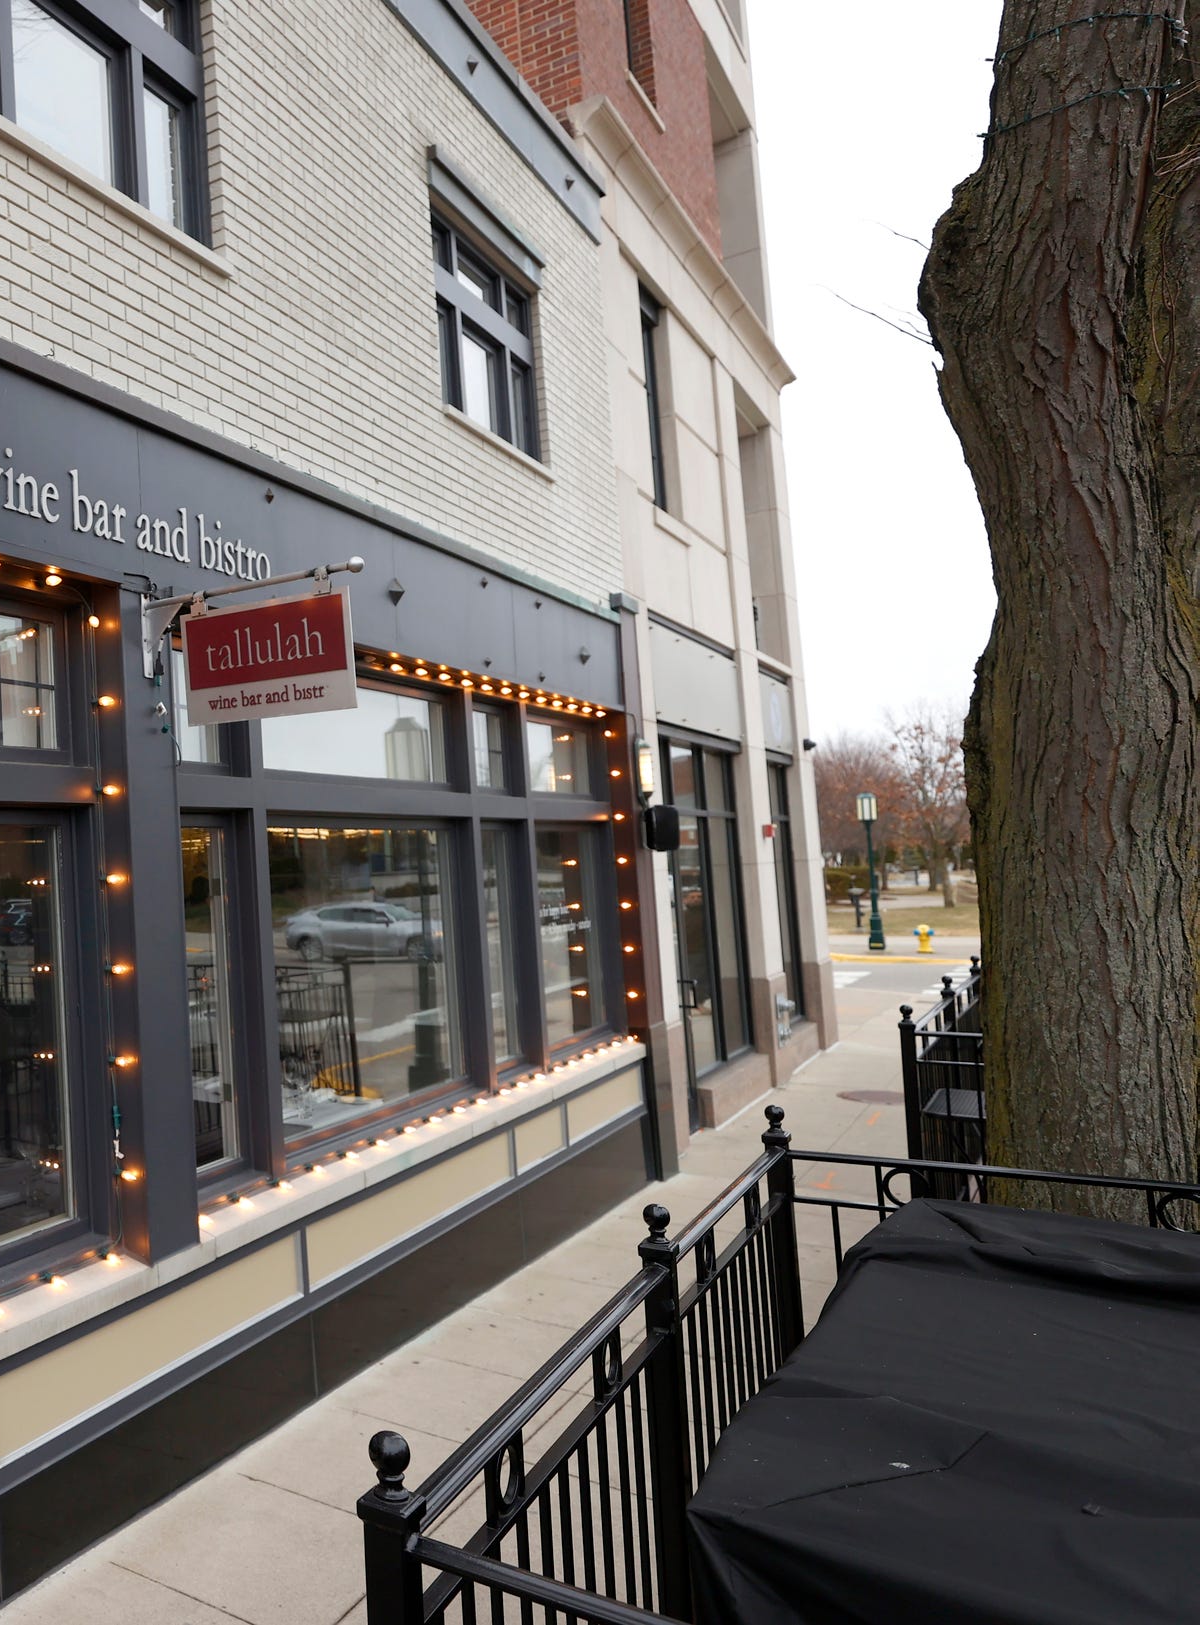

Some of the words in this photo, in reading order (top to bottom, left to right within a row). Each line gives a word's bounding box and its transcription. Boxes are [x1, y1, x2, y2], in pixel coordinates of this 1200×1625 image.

[68, 469, 126, 544] bar
[136, 507, 191, 563] and
[197, 513, 272, 581] bistro
[205, 617, 325, 672] tallulah
[208, 695, 238, 711] wine
[240, 690, 262, 707] bar
[265, 684, 289, 704] and
